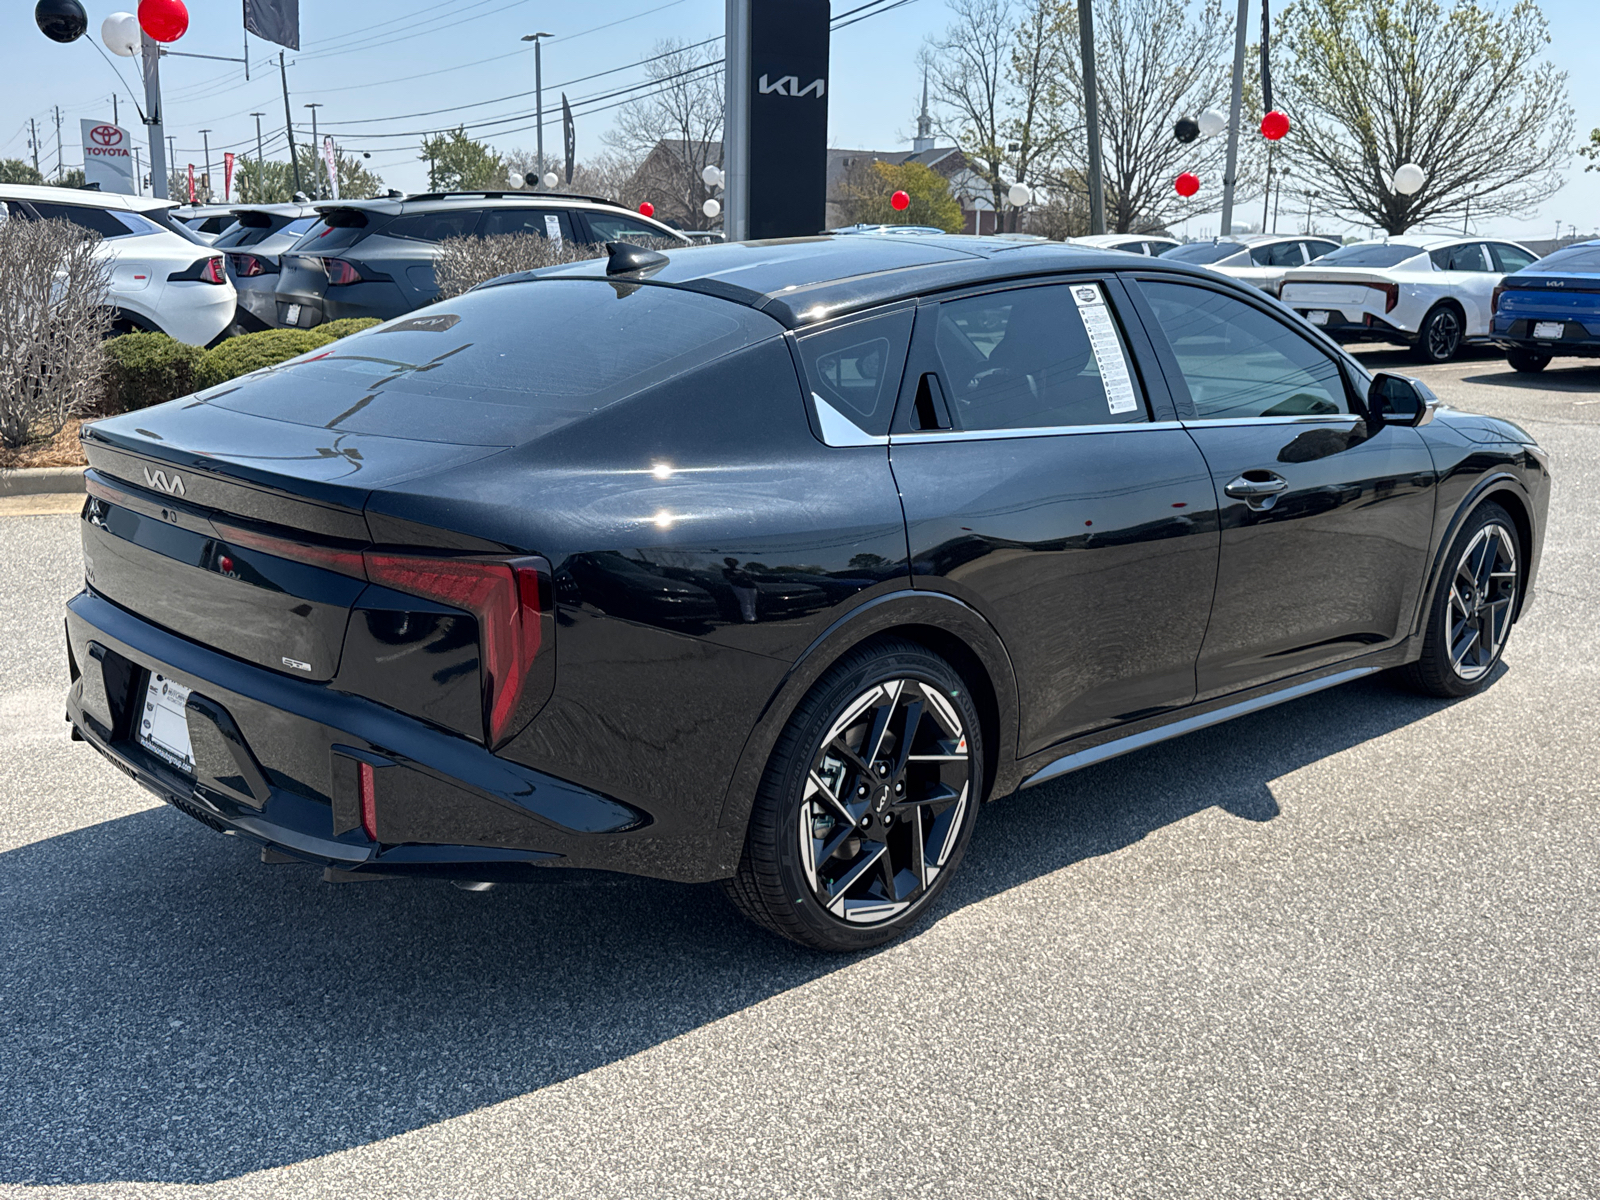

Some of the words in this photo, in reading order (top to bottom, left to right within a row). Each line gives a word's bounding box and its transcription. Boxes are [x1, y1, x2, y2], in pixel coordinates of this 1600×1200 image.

[759, 73, 825, 99] KIA
[85, 147, 130, 157] TOYOTA
[143, 466, 186, 497] KIA
[957, 692, 981, 752] KUMHO
[787, 761, 804, 804] 235/40
[799, 734, 814, 760] R18
[812, 708, 830, 735] 91W
[829, 681, 857, 709] OUTSIDE
